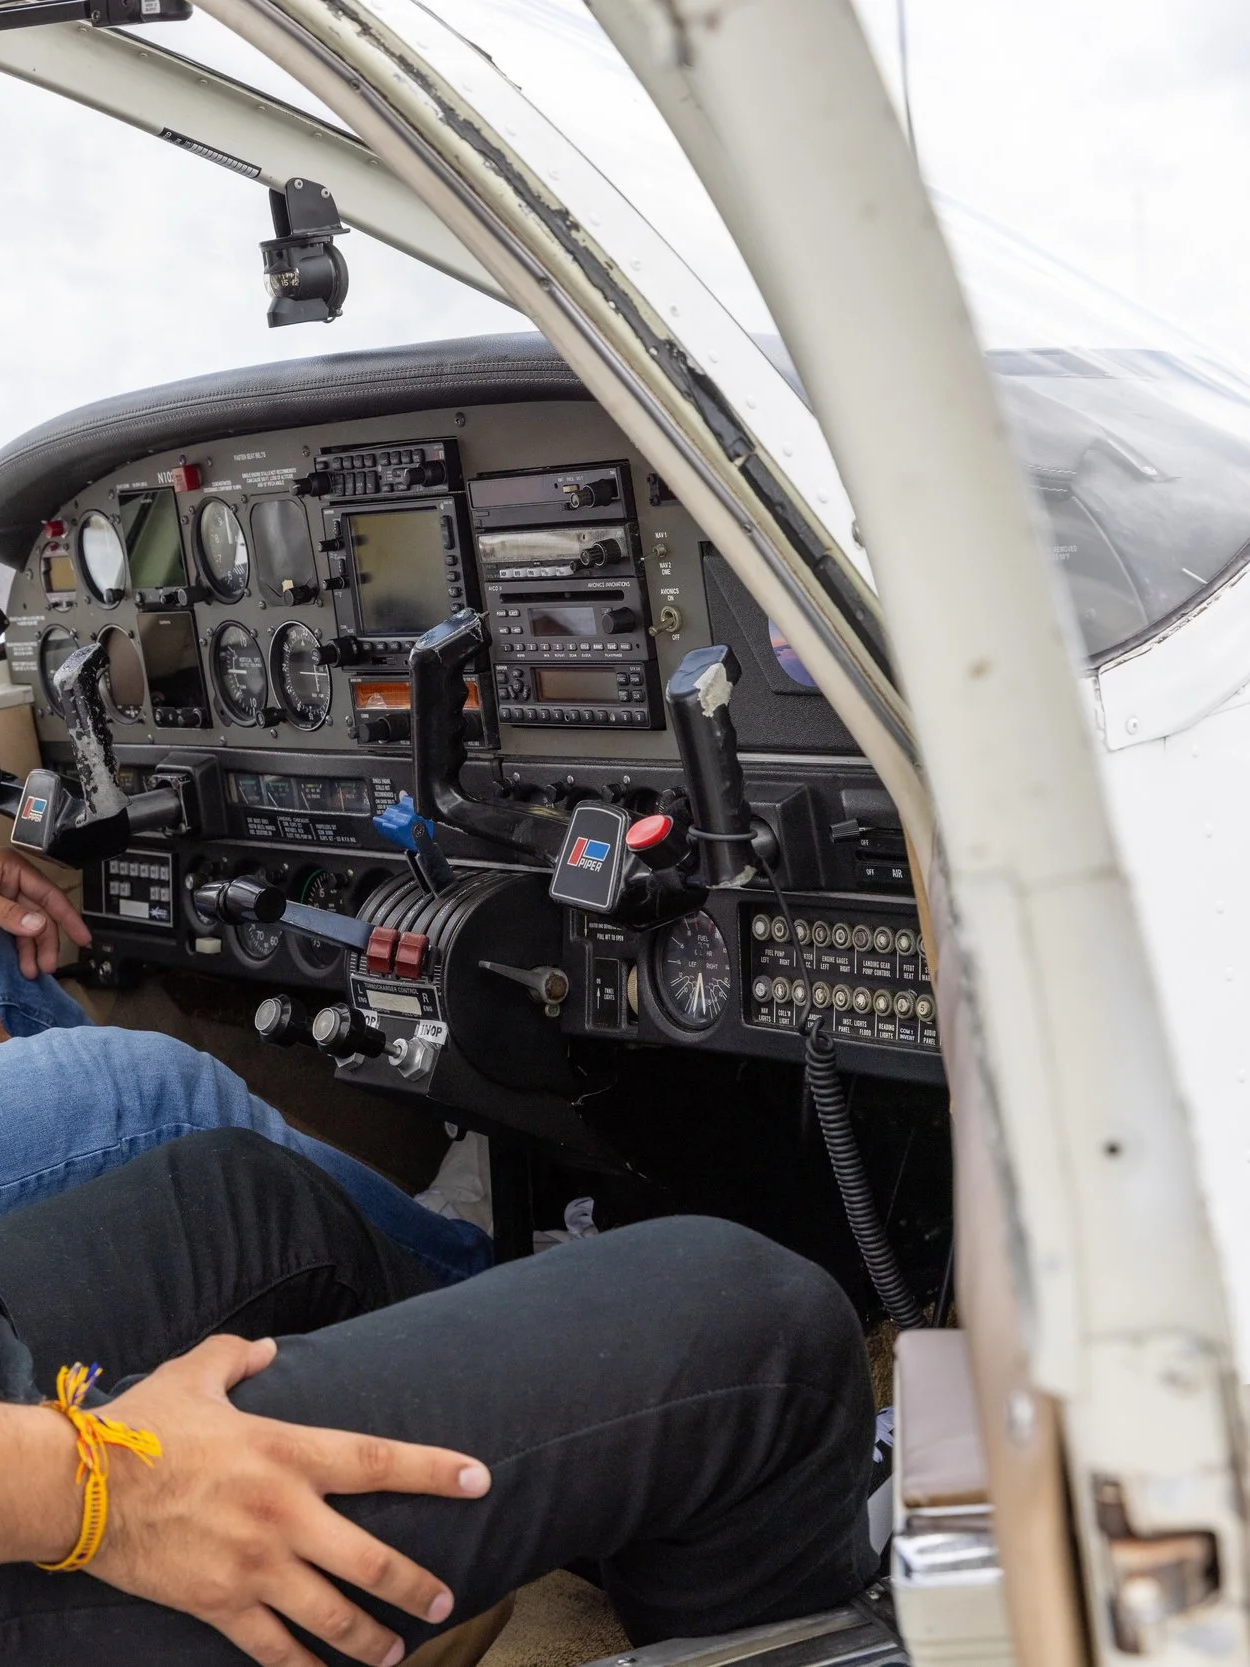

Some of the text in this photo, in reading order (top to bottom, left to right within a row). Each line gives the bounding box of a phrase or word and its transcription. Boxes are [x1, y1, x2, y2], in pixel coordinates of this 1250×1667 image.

[578, 858, 602, 872] PIPER
[866, 868, 903, 878] OFF AIR
[256, 930, 264, 940] 70
[270, 936, 278, 945] 60
[760, 956, 790, 966] LEFT RIGHT
[822, 955, 835, 963] ENGINE
[862, 960, 879, 968] LANDING
[903, 964, 915, 972] PITOT
[840, 965, 850, 973] RIGHT
[862, 968, 891, 978] PUMP CONTROL
[904, 972, 914, 980] HEAT
[358, 983, 429, 1003] L TURBOCHARGER CONTROL R
[842, 1018, 867, 1028] INST. LIGHTS
[878, 1023, 895, 1031] READING
[422, 1024, 442, 1037] INOP
[880, 1031, 893, 1039] LIGHTS
[923, 1037, 936, 1045] PANEL
